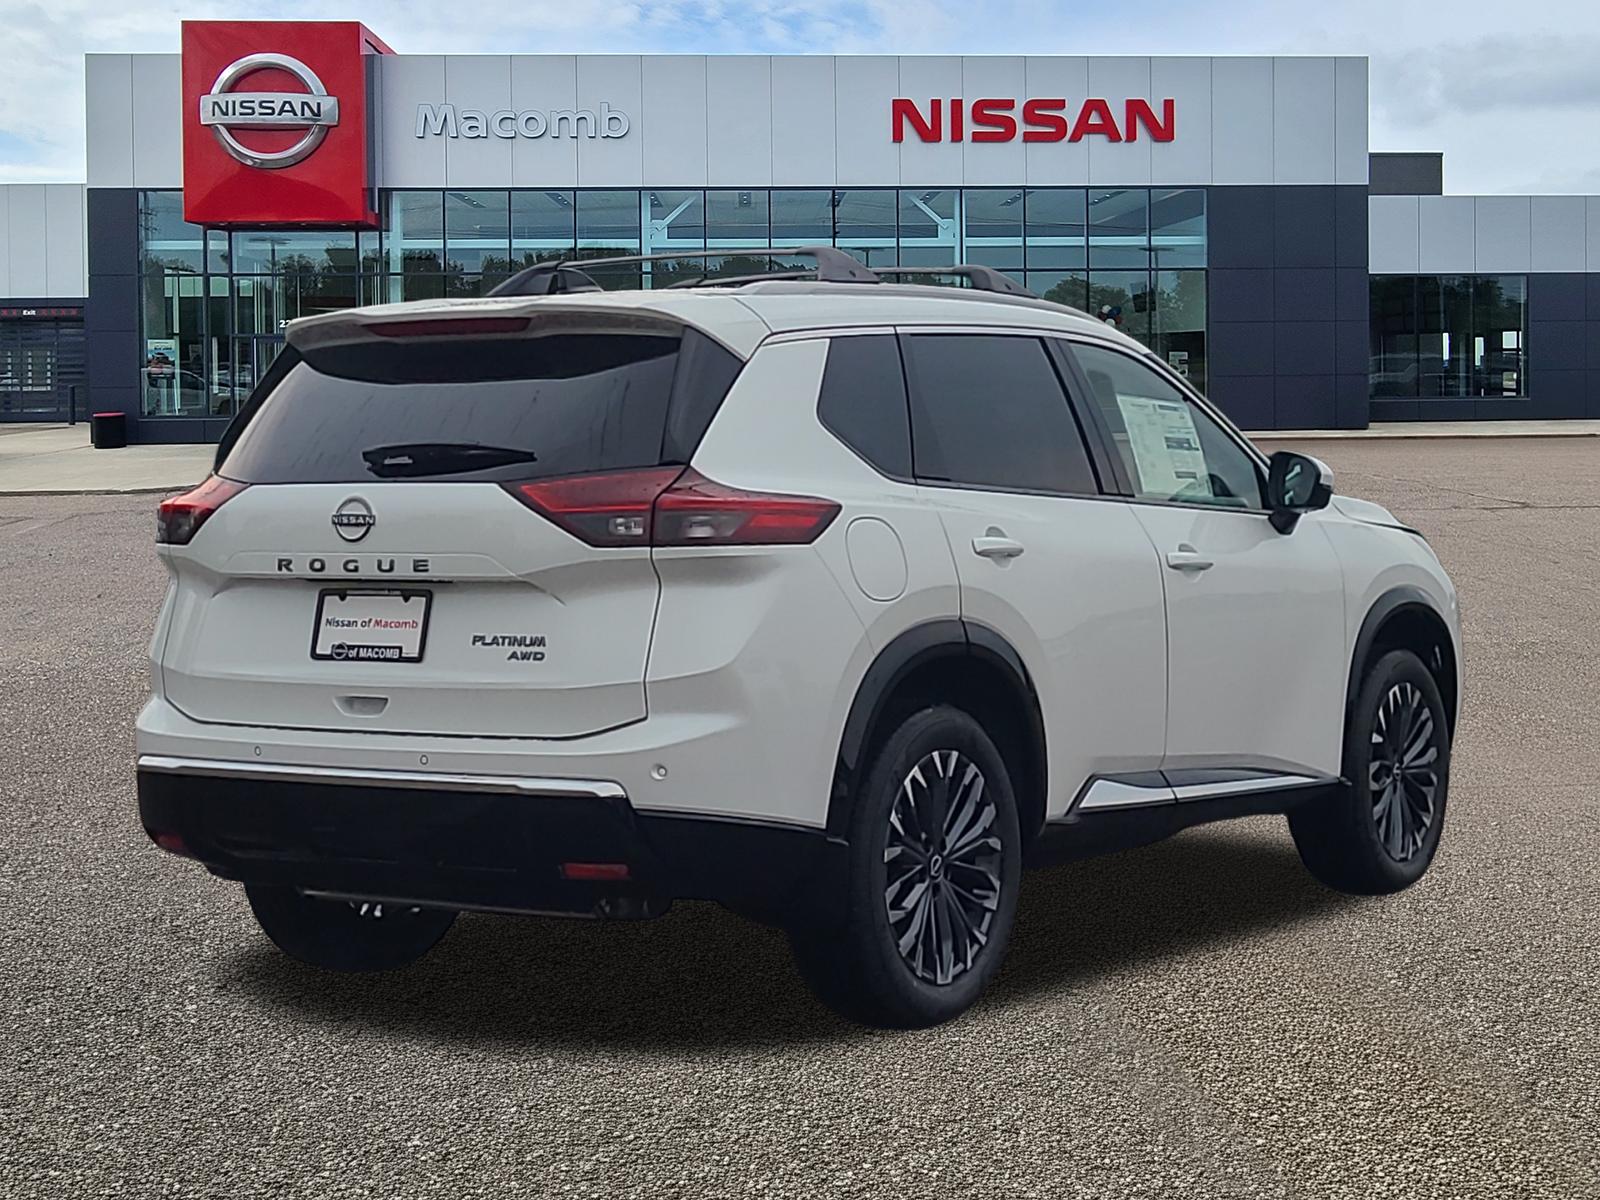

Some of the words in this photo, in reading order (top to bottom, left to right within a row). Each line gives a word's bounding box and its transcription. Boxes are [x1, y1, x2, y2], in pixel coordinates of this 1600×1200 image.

[212, 100, 322, 117] NISSAN
[415, 102, 630, 139] Macomb
[892, 98, 1175, 142] NISSAN
[332, 515, 375, 525] NISSAN
[277, 558, 430, 573] ROGUE
[325, 617, 358, 628] Nissan
[360, 618, 372, 628] of
[373, 618, 418, 629] Macomb
[471, 635, 547, 647] PLATINUM
[348, 647, 358, 658] of
[359, 647, 400, 658] MACOMB
[507, 651, 546, 661] AWD
